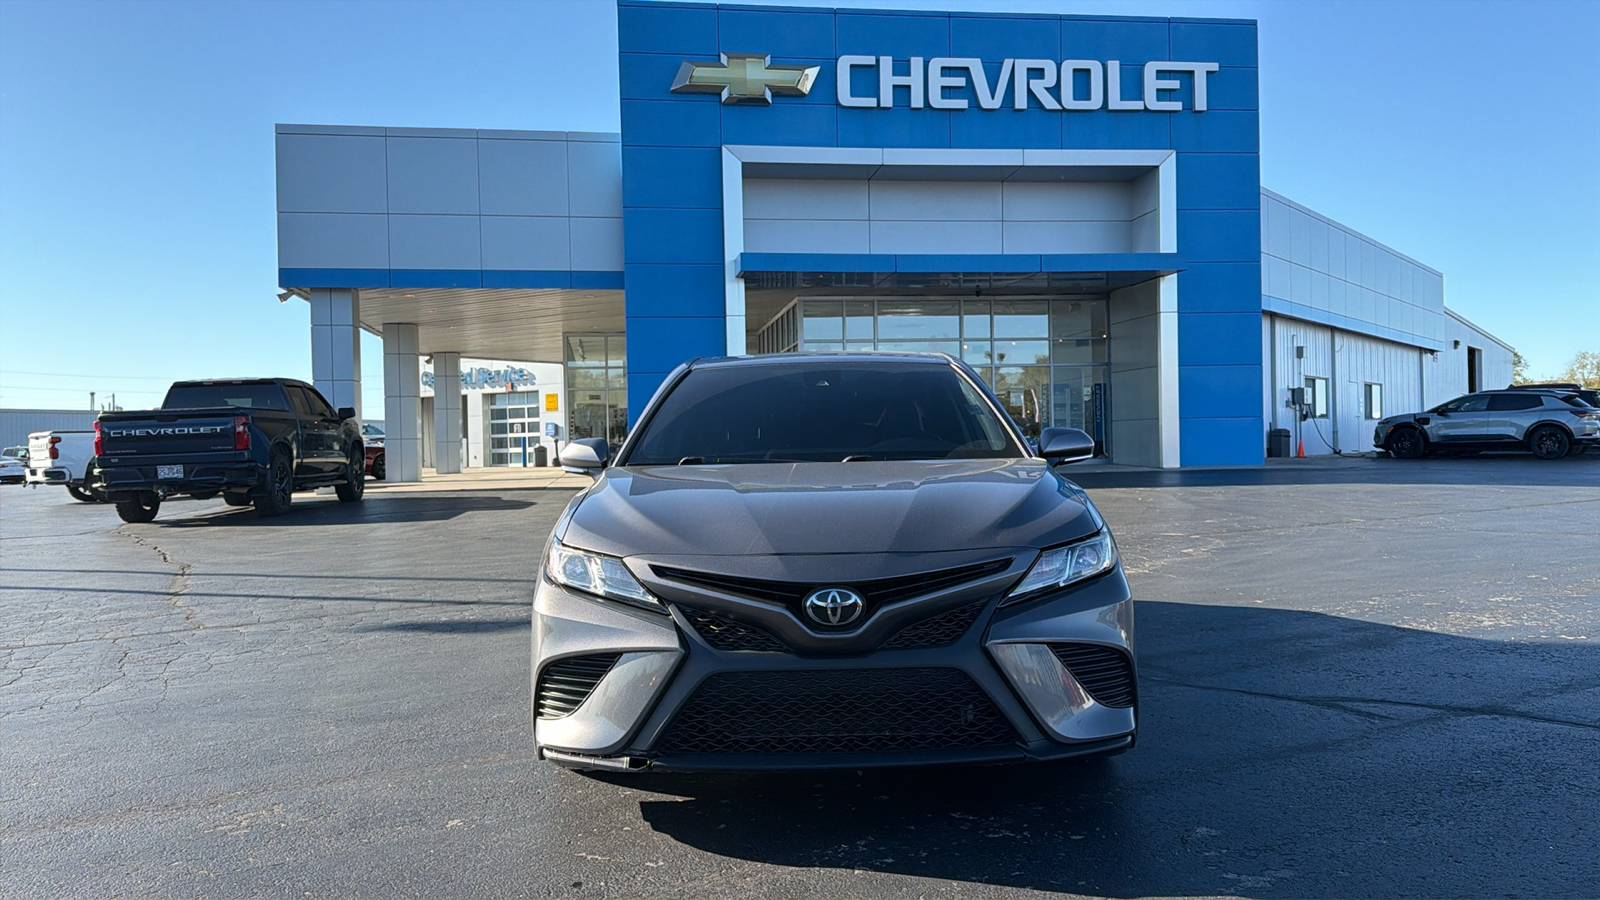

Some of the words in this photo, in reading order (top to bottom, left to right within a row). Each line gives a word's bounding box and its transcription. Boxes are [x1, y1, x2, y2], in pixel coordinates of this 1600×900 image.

[836, 54, 1220, 112] CHEVROLET
[478, 365, 528, 384] Service
[110, 426, 225, 437] CHEVROLET
